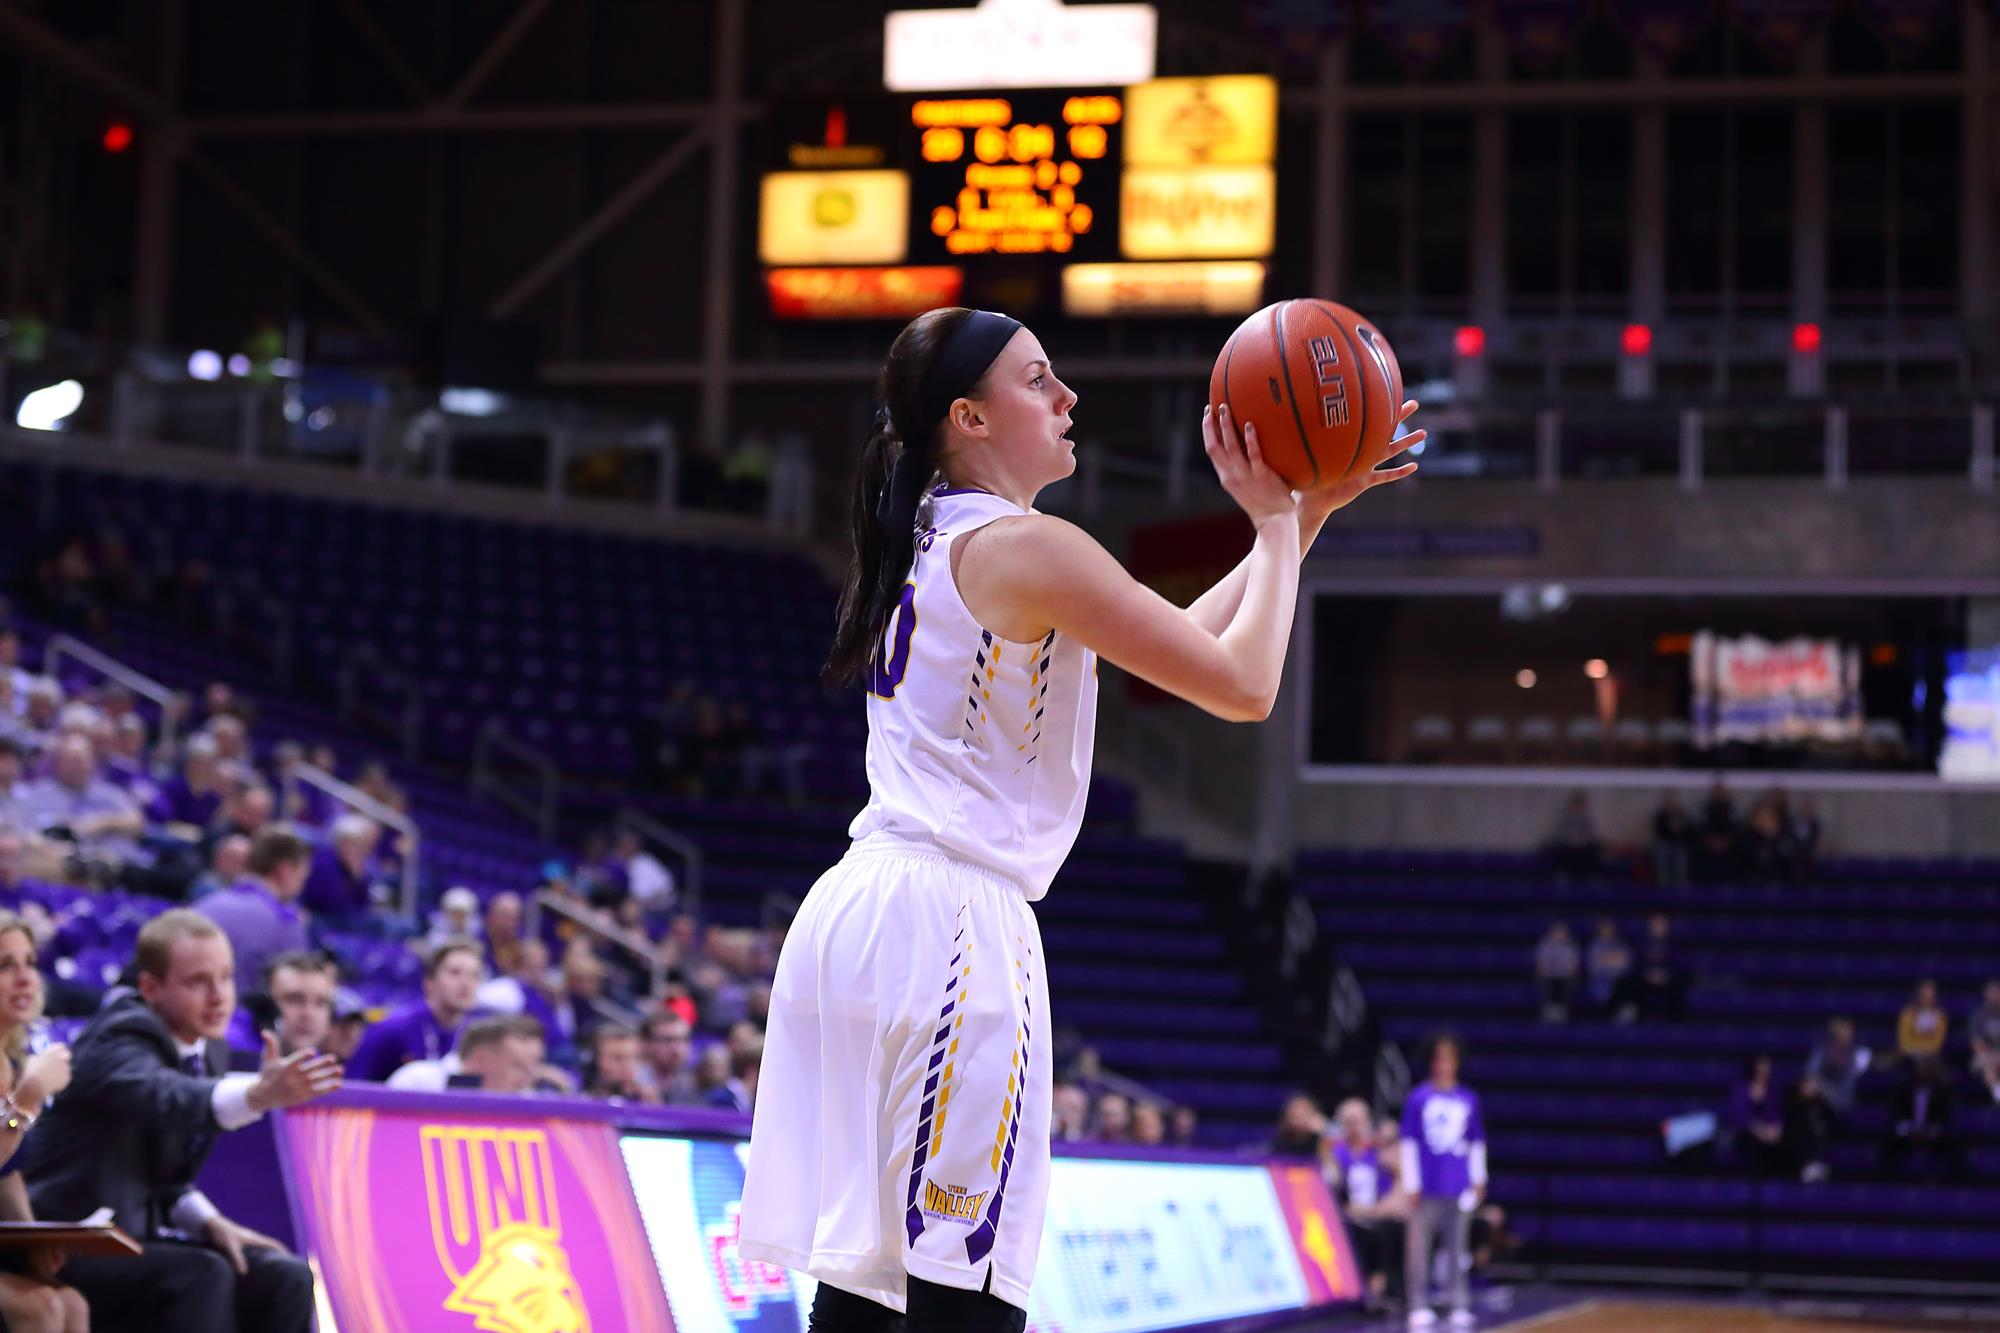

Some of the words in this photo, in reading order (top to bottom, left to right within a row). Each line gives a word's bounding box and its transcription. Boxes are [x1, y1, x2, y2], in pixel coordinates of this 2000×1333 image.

[1309, 336, 1350, 429] ELITE
[419, 1125, 561, 1283] UNI
[924, 1178, 989, 1220] VALLEY
